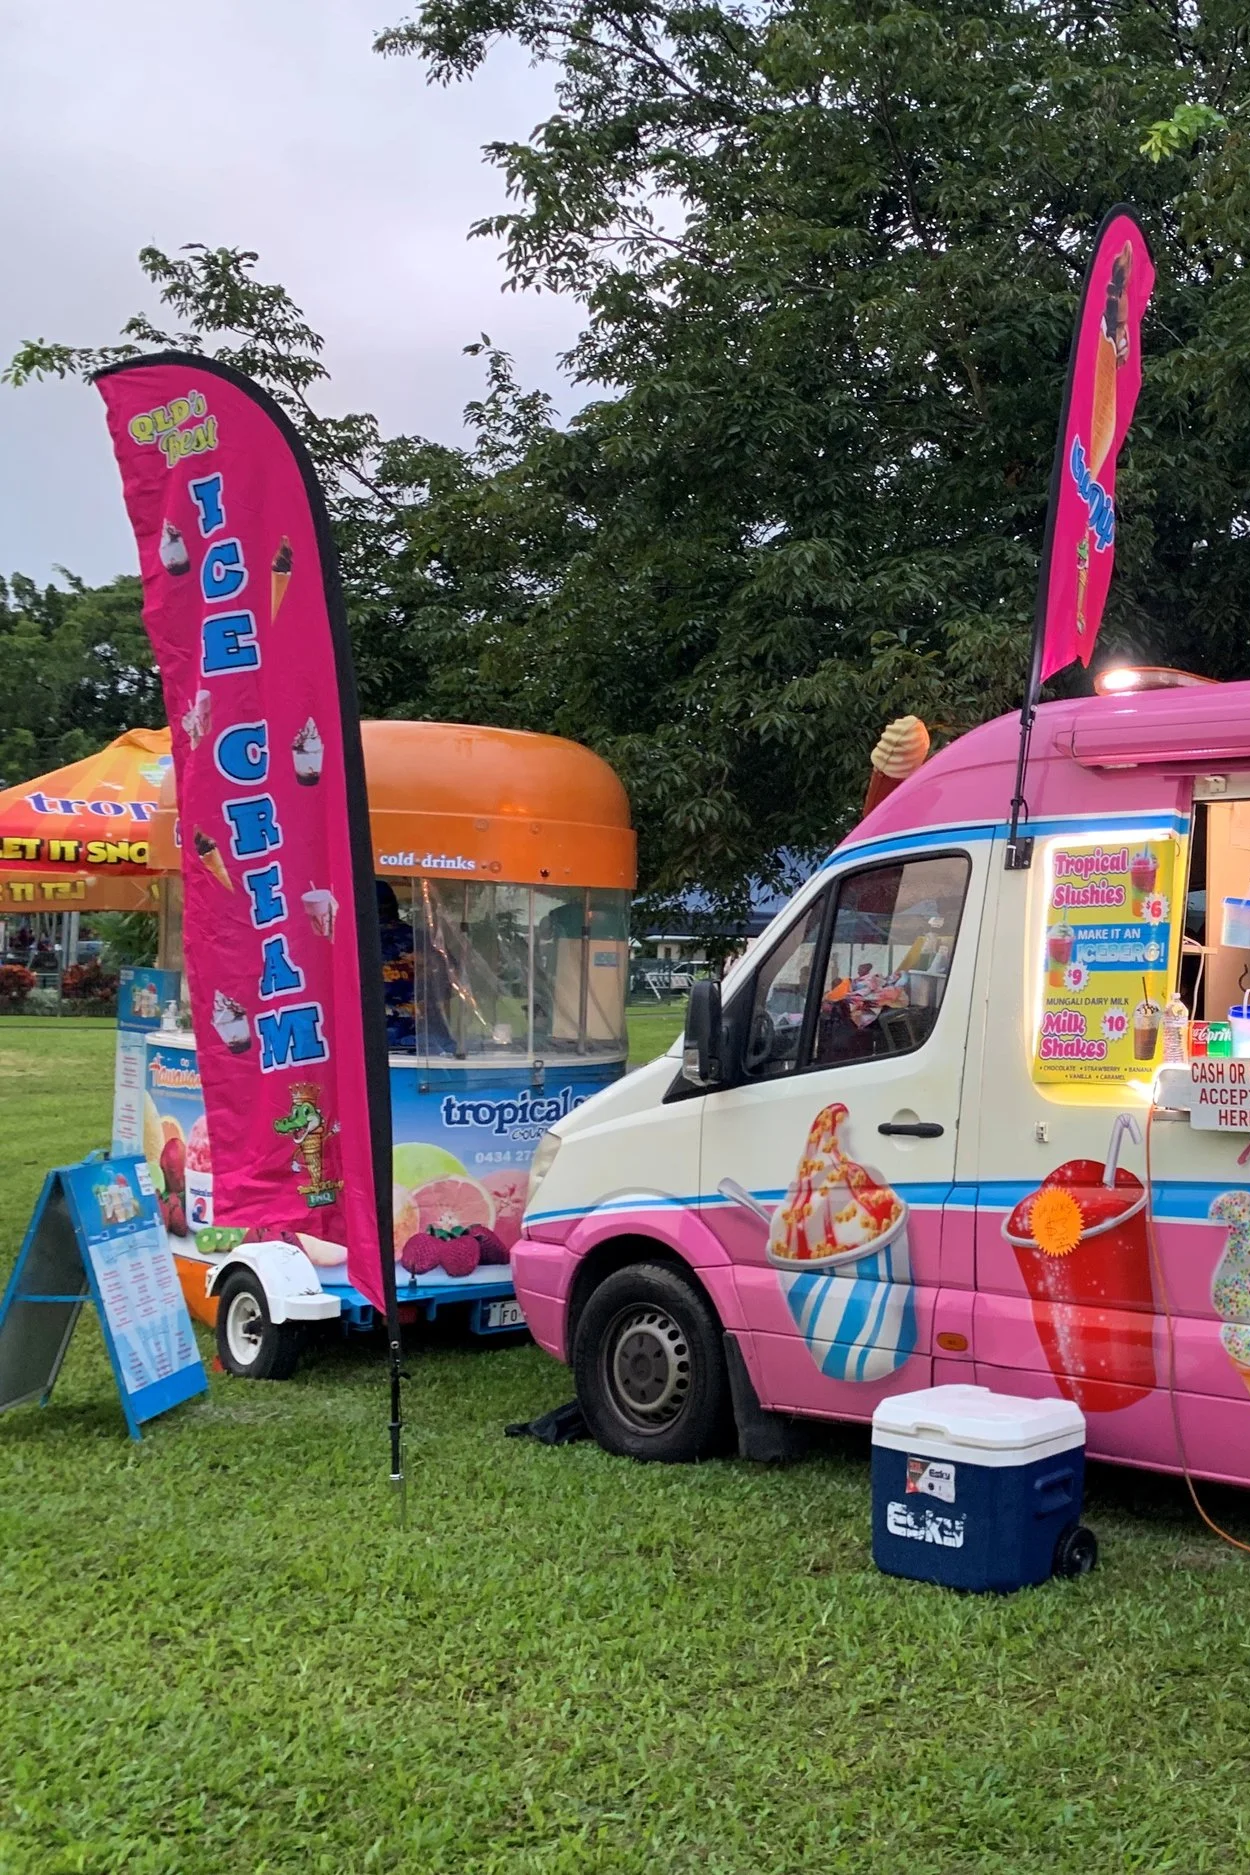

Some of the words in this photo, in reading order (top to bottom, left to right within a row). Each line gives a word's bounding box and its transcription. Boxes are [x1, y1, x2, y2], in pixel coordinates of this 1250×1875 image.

[189, 472, 262, 678] ICE
[0, 837, 41, 859] ET
[48, 839, 79, 862] IT
[86, 841, 149, 864] SNO
[380, 852, 414, 866] cold
[421, 853, 476, 870] drinks
[1054, 847, 1129, 880] Tropical
[214, 718, 330, 1075] CREAM
[1052, 878, 1125, 909] Slushies
[1146, 900, 1162, 918] $6
[1078, 929, 1108, 940] MAKE
[1111, 929, 1122, 939] IT
[1124, 928, 1141, 939] AN
[1077, 942, 1165, 963] ICEBERG!
[1067, 969, 1083, 986] $9
[1084, 998, 1108, 1006] DAIRY
[1109, 998, 1129, 1006] MILK
[1041, 1008, 1087, 1036] Milk
[1103, 1015, 1126, 1032] $10
[1039, 1036, 1107, 1060] Shakes
[1191, 1062, 1224, 1084] CASH
[1229, 1063, 1246, 1085] OR
[475, 1151, 512, 1164] 0434
[515, 1150, 536, 1162] 27
